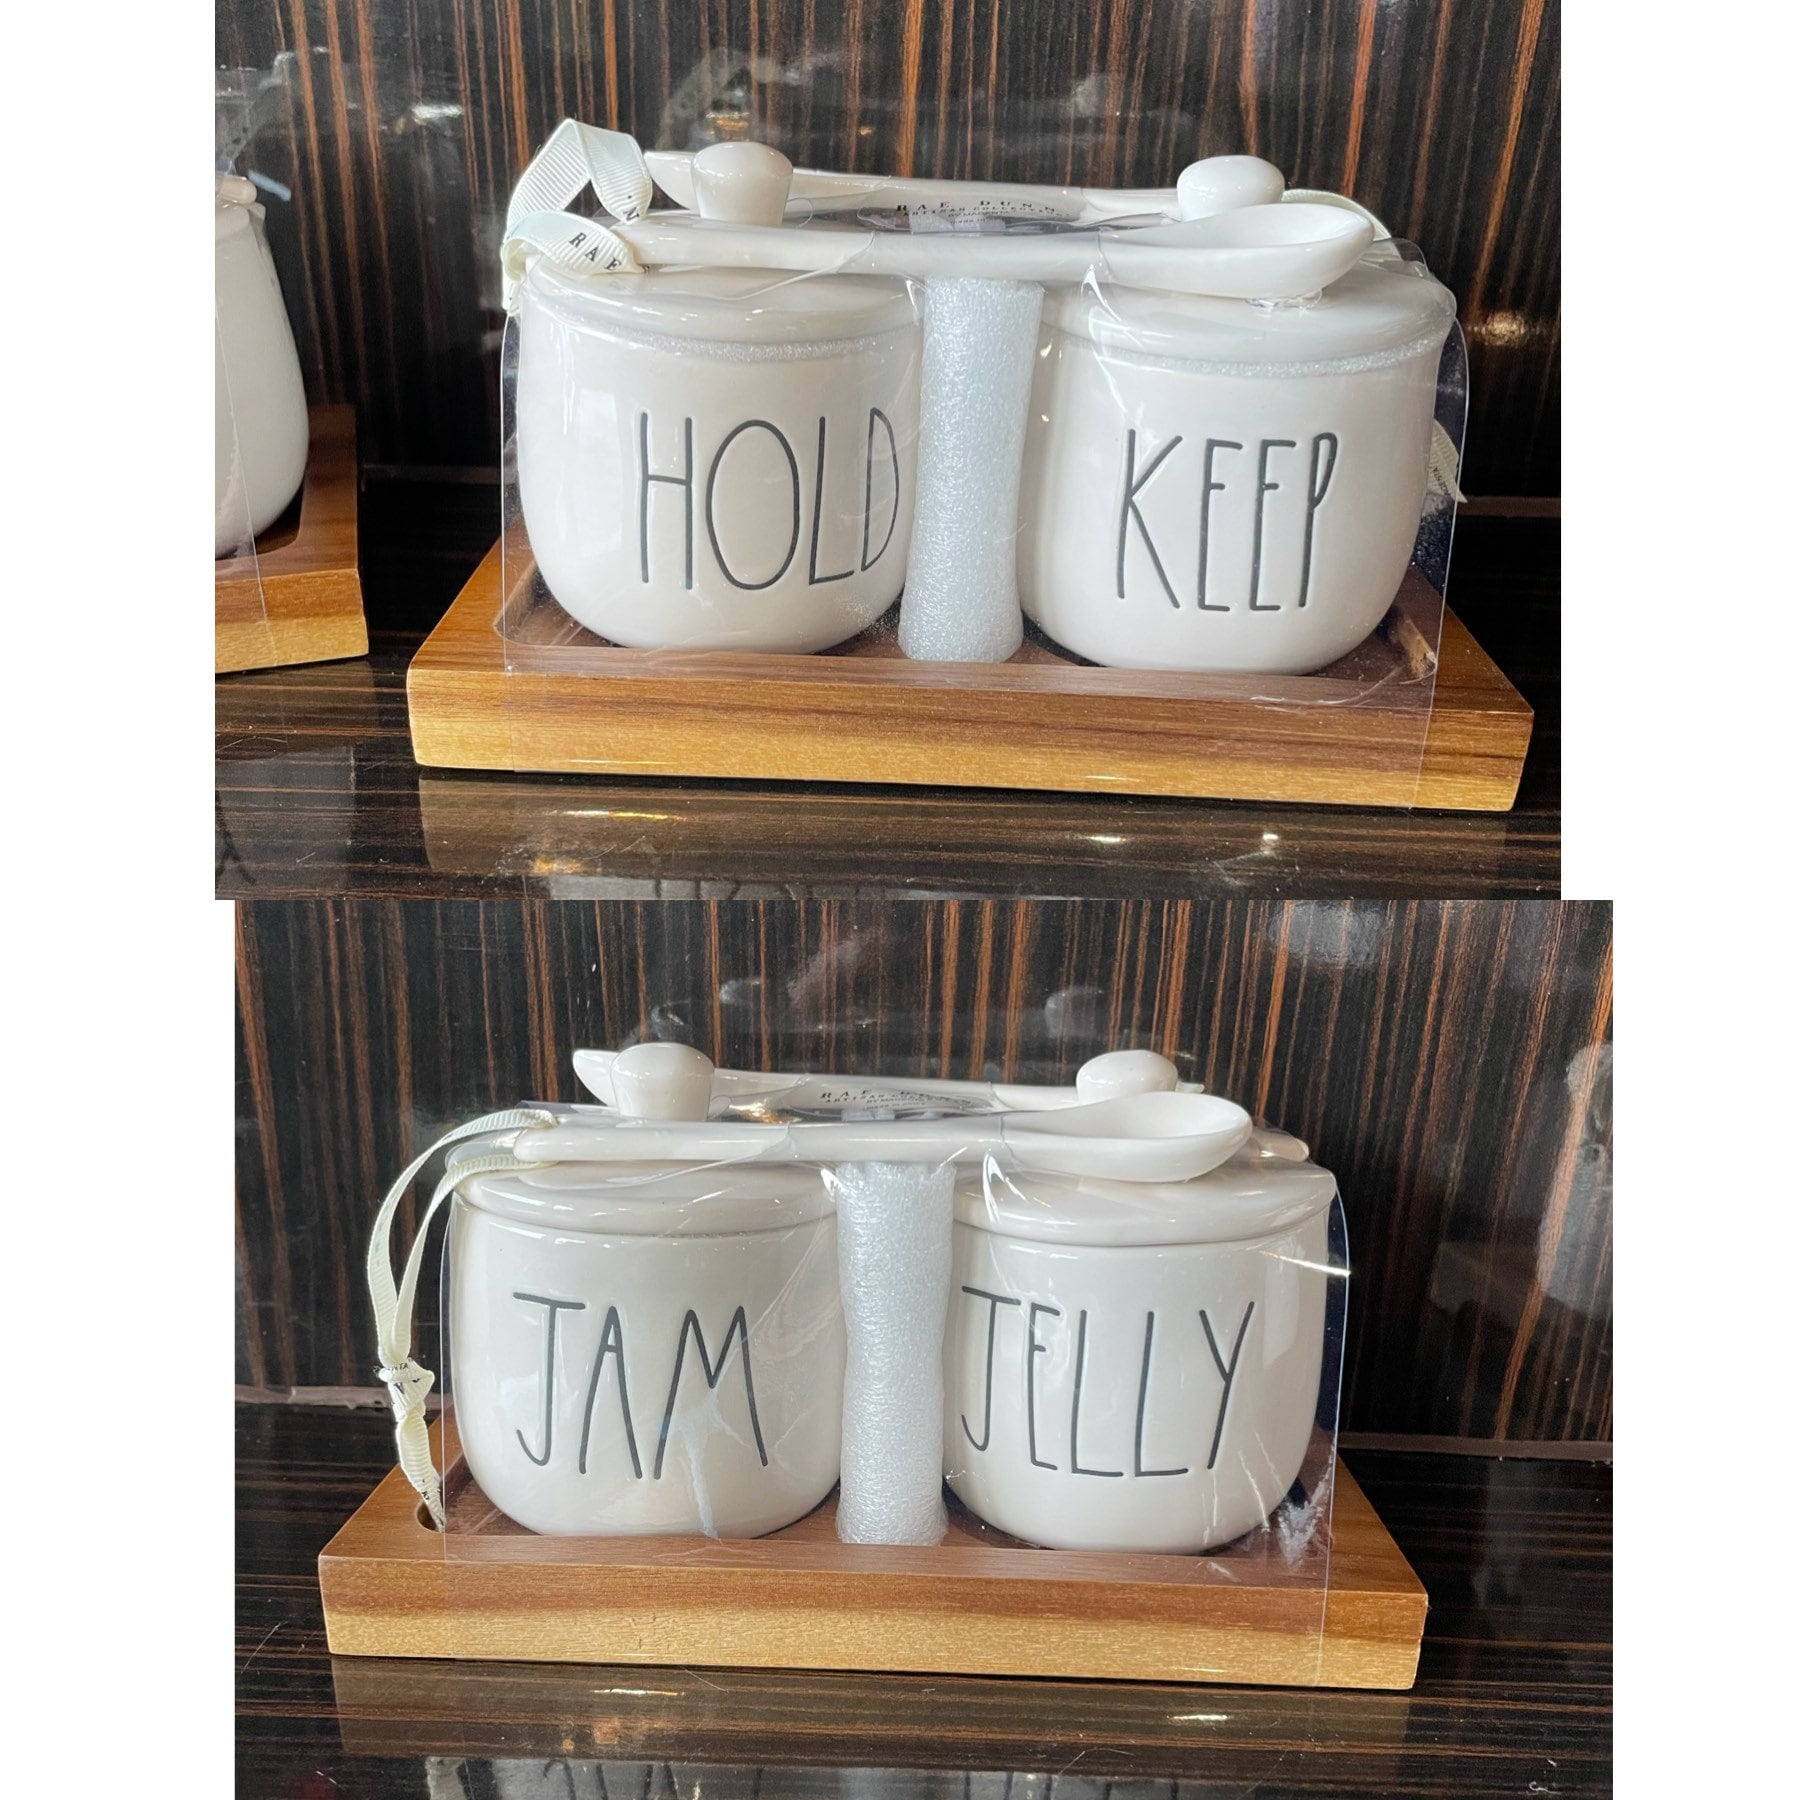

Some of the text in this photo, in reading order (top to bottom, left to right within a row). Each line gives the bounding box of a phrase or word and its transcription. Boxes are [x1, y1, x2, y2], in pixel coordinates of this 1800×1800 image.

[568, 231, 622, 272] RAE
[896, 200, 1055, 212] RAE DUNN
[640, 407, 900, 591] HOLD
[1116, 428, 1338, 612] KEEP
[820, 1089, 872, 1099] RAE
[512, 1291, 769, 1480] JAM
[961, 1285, 1257, 1477] JELLY
